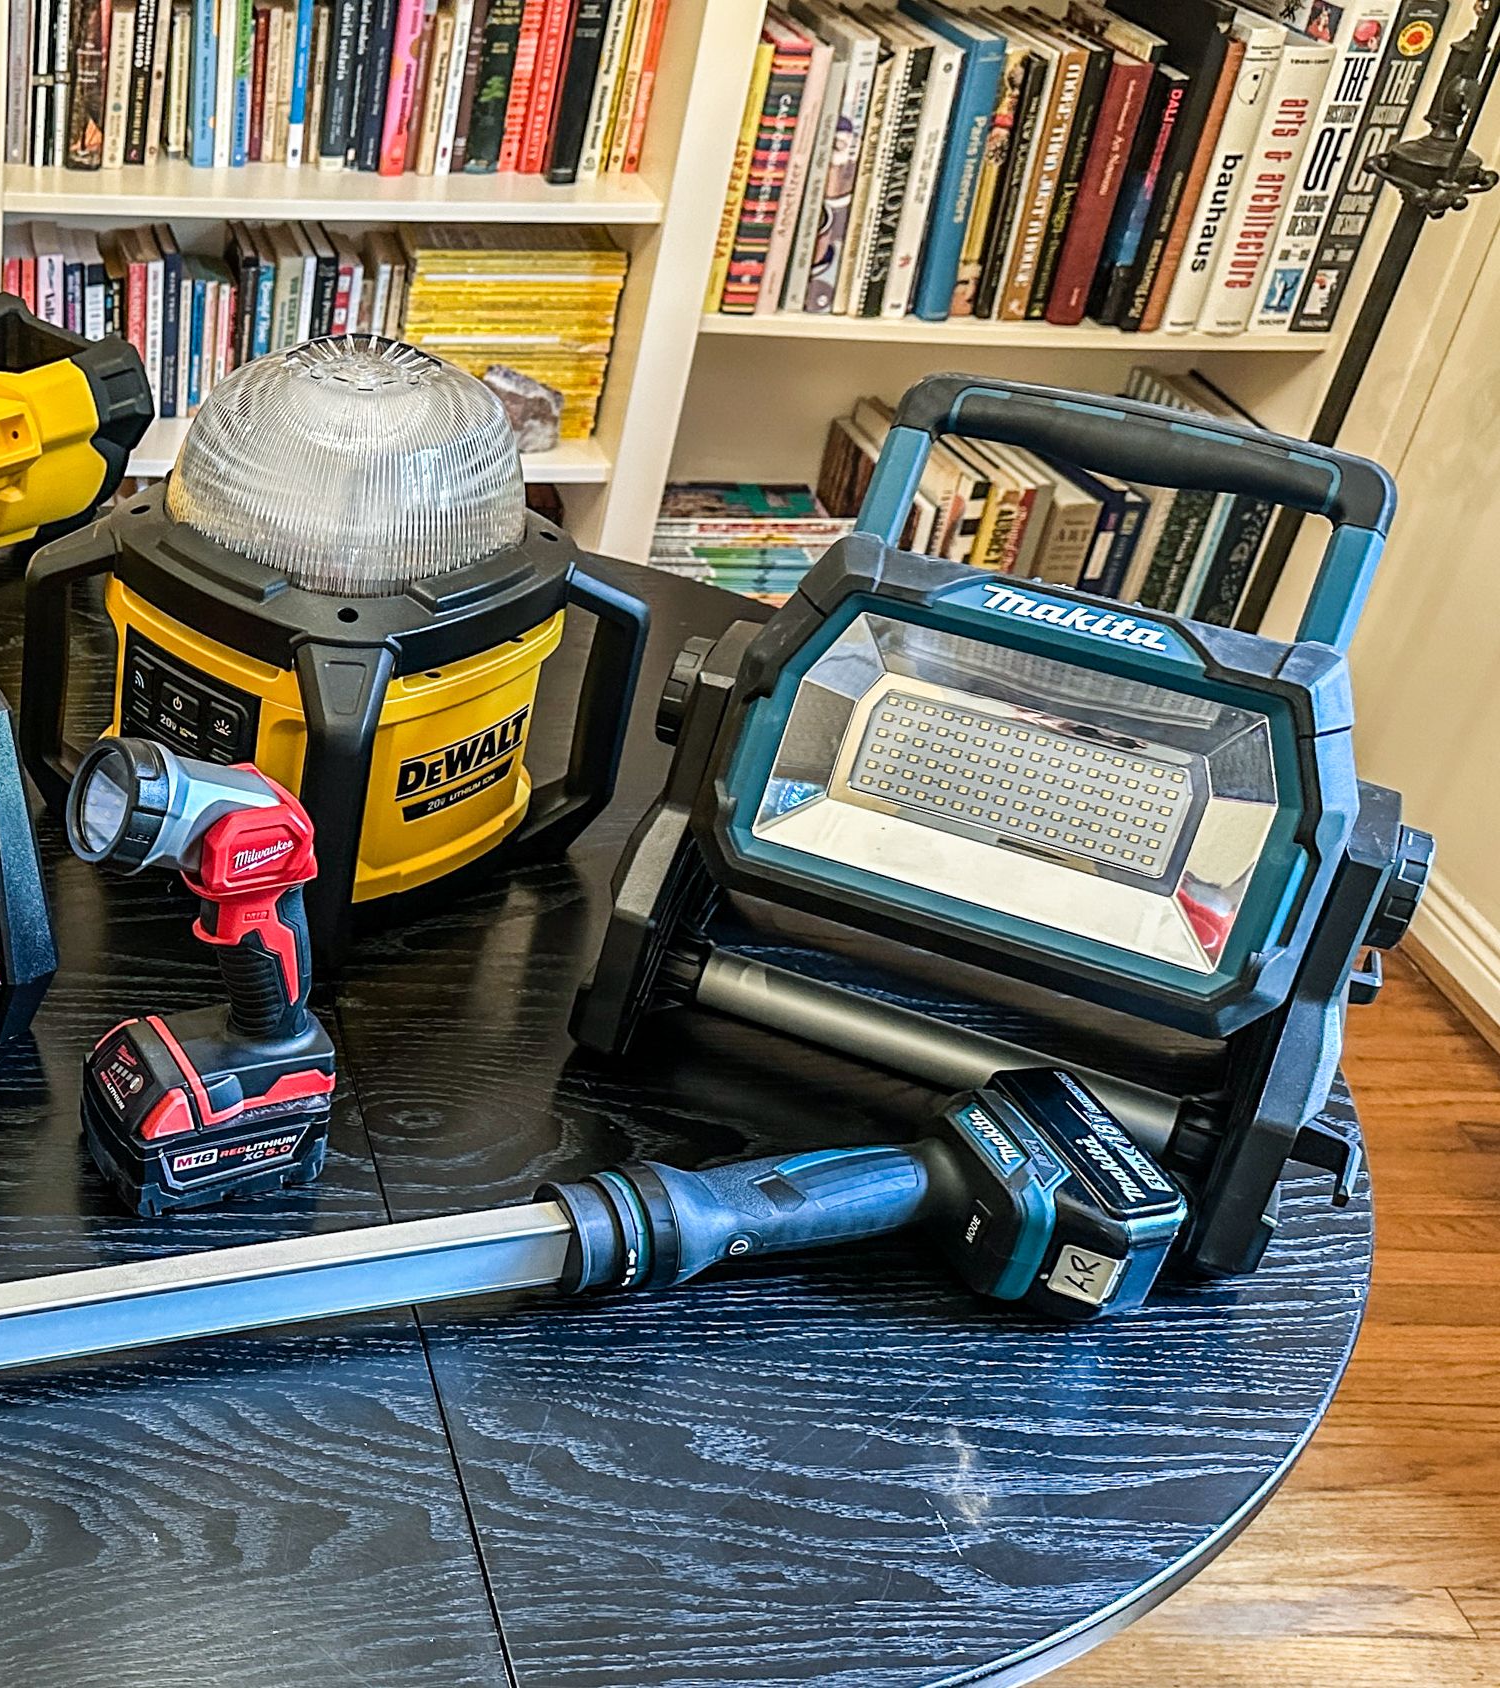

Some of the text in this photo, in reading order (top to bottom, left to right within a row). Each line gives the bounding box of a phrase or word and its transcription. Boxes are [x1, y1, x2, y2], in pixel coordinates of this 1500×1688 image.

[341, 2, 355, 37] david
[134, 34, 146, 68] HUGO
[336, 39, 350, 81] sedaris
[1334, 57, 1375, 102] THE
[1379, 60, 1422, 105] THE
[896, 80, 929, 161] THE
[1163, 88, 1183, 123] DALI
[968, 114, 988, 157] Paris
[1303, 127, 1353, 191] OF
[714, 140, 752, 260] VISUAL FEAST
[1191, 153, 1243, 273] bauhaus
[1225, 98, 1308, 289] arts & architecture
[869, 162, 911, 283] MOVIES
[449, 781, 482, 802] LITHIUM
[482, 772, 496, 786] ION
[233, 838, 294, 869] Milwaukee
[176, 1151, 216, 1171] M18
[220, 1133, 298, 1159] REDLITHIUM
[966, 1213, 982, 1244] MODE
